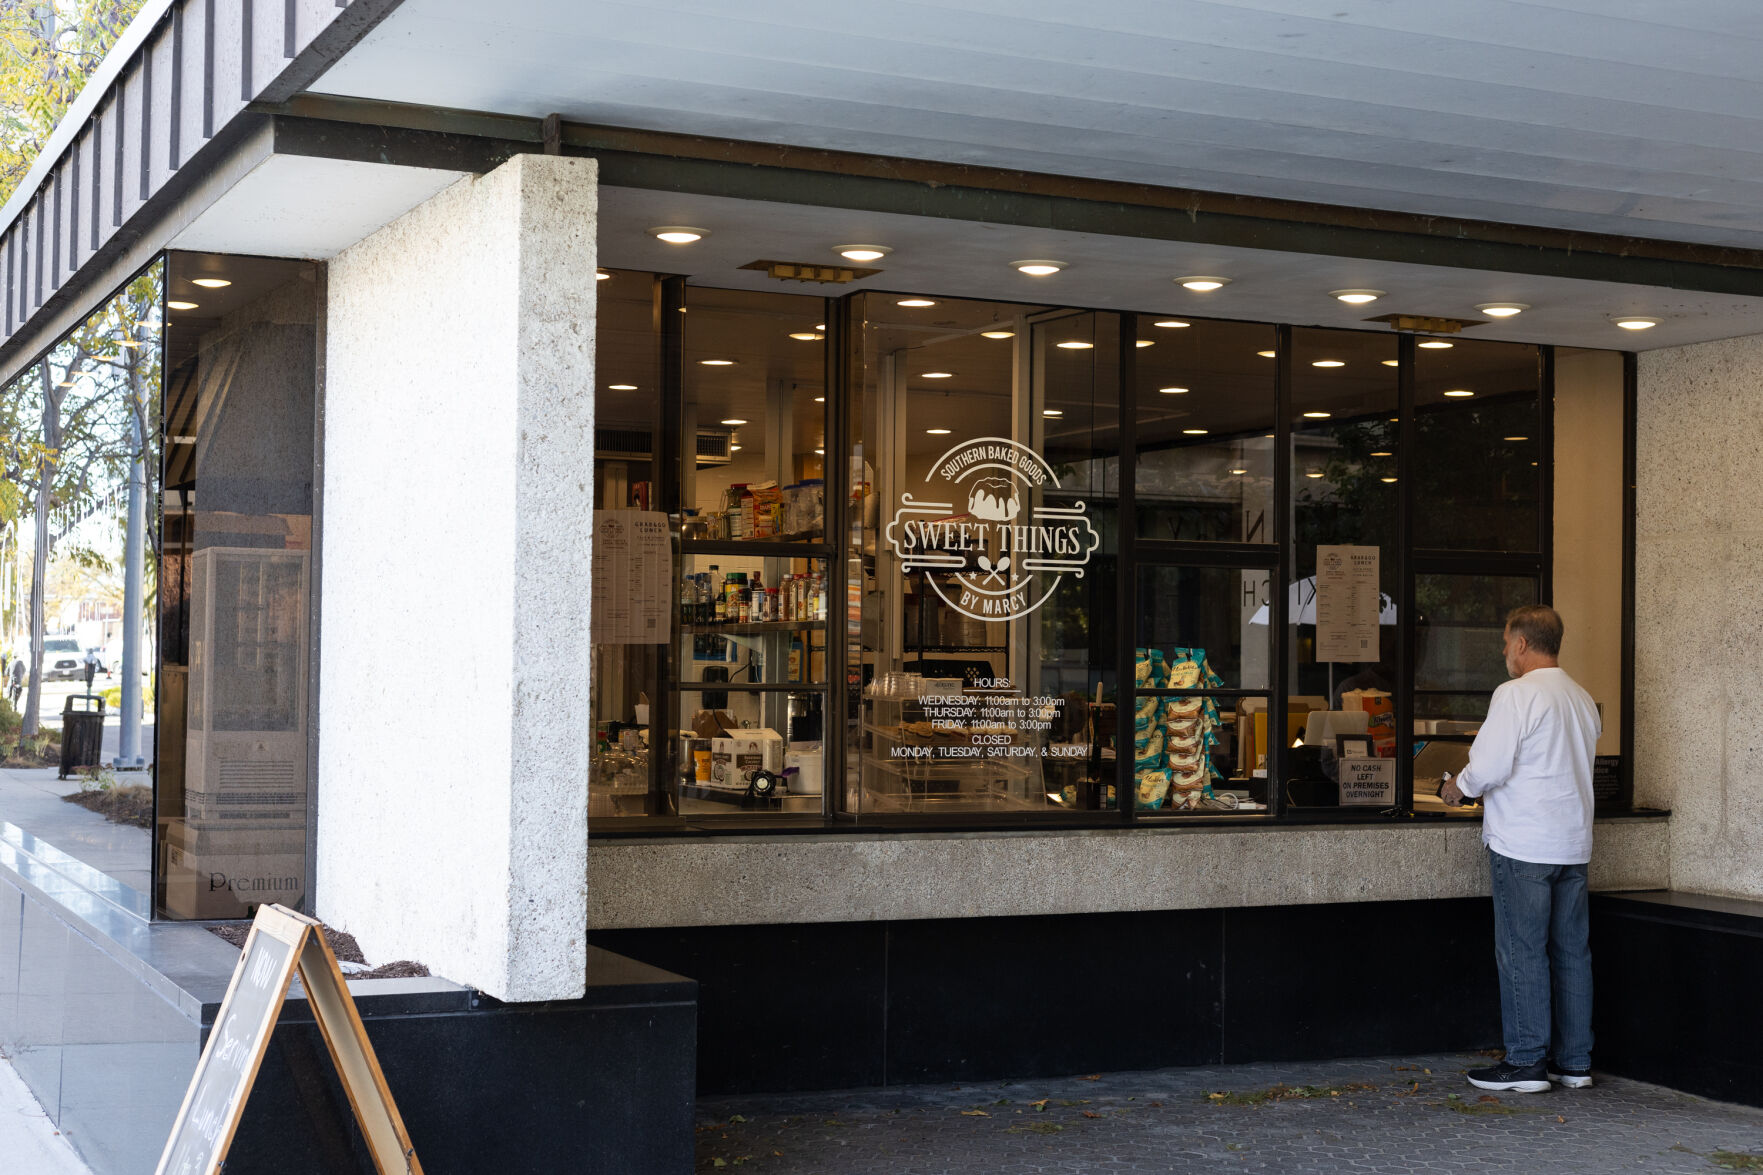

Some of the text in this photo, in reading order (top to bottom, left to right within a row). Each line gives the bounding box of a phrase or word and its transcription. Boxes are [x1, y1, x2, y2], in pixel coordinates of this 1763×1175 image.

[940, 445, 1047, 485] SOUTHERN BAKED GOODS
[903, 520, 1081, 555] SWEET THINGS
[960, 590, 1027, 615] BY MARCY
[973, 677, 1011, 688] HOURS:
[918, 695, 1065, 708] WEDNESDAY: 11:00am to 3:00pm
[922, 707, 1061, 720] THURSDAY: 11:00am to 3:00pm
[931, 719, 1052, 731] FRIDAY: 11:00am to 3:00pm
[971, 735, 1012, 745] CLOSED
[890, 746, 1088, 758] MONDAY, TUESDAY, SATURDAY, & SUNDAY
[208, 872, 299, 892] Premium
